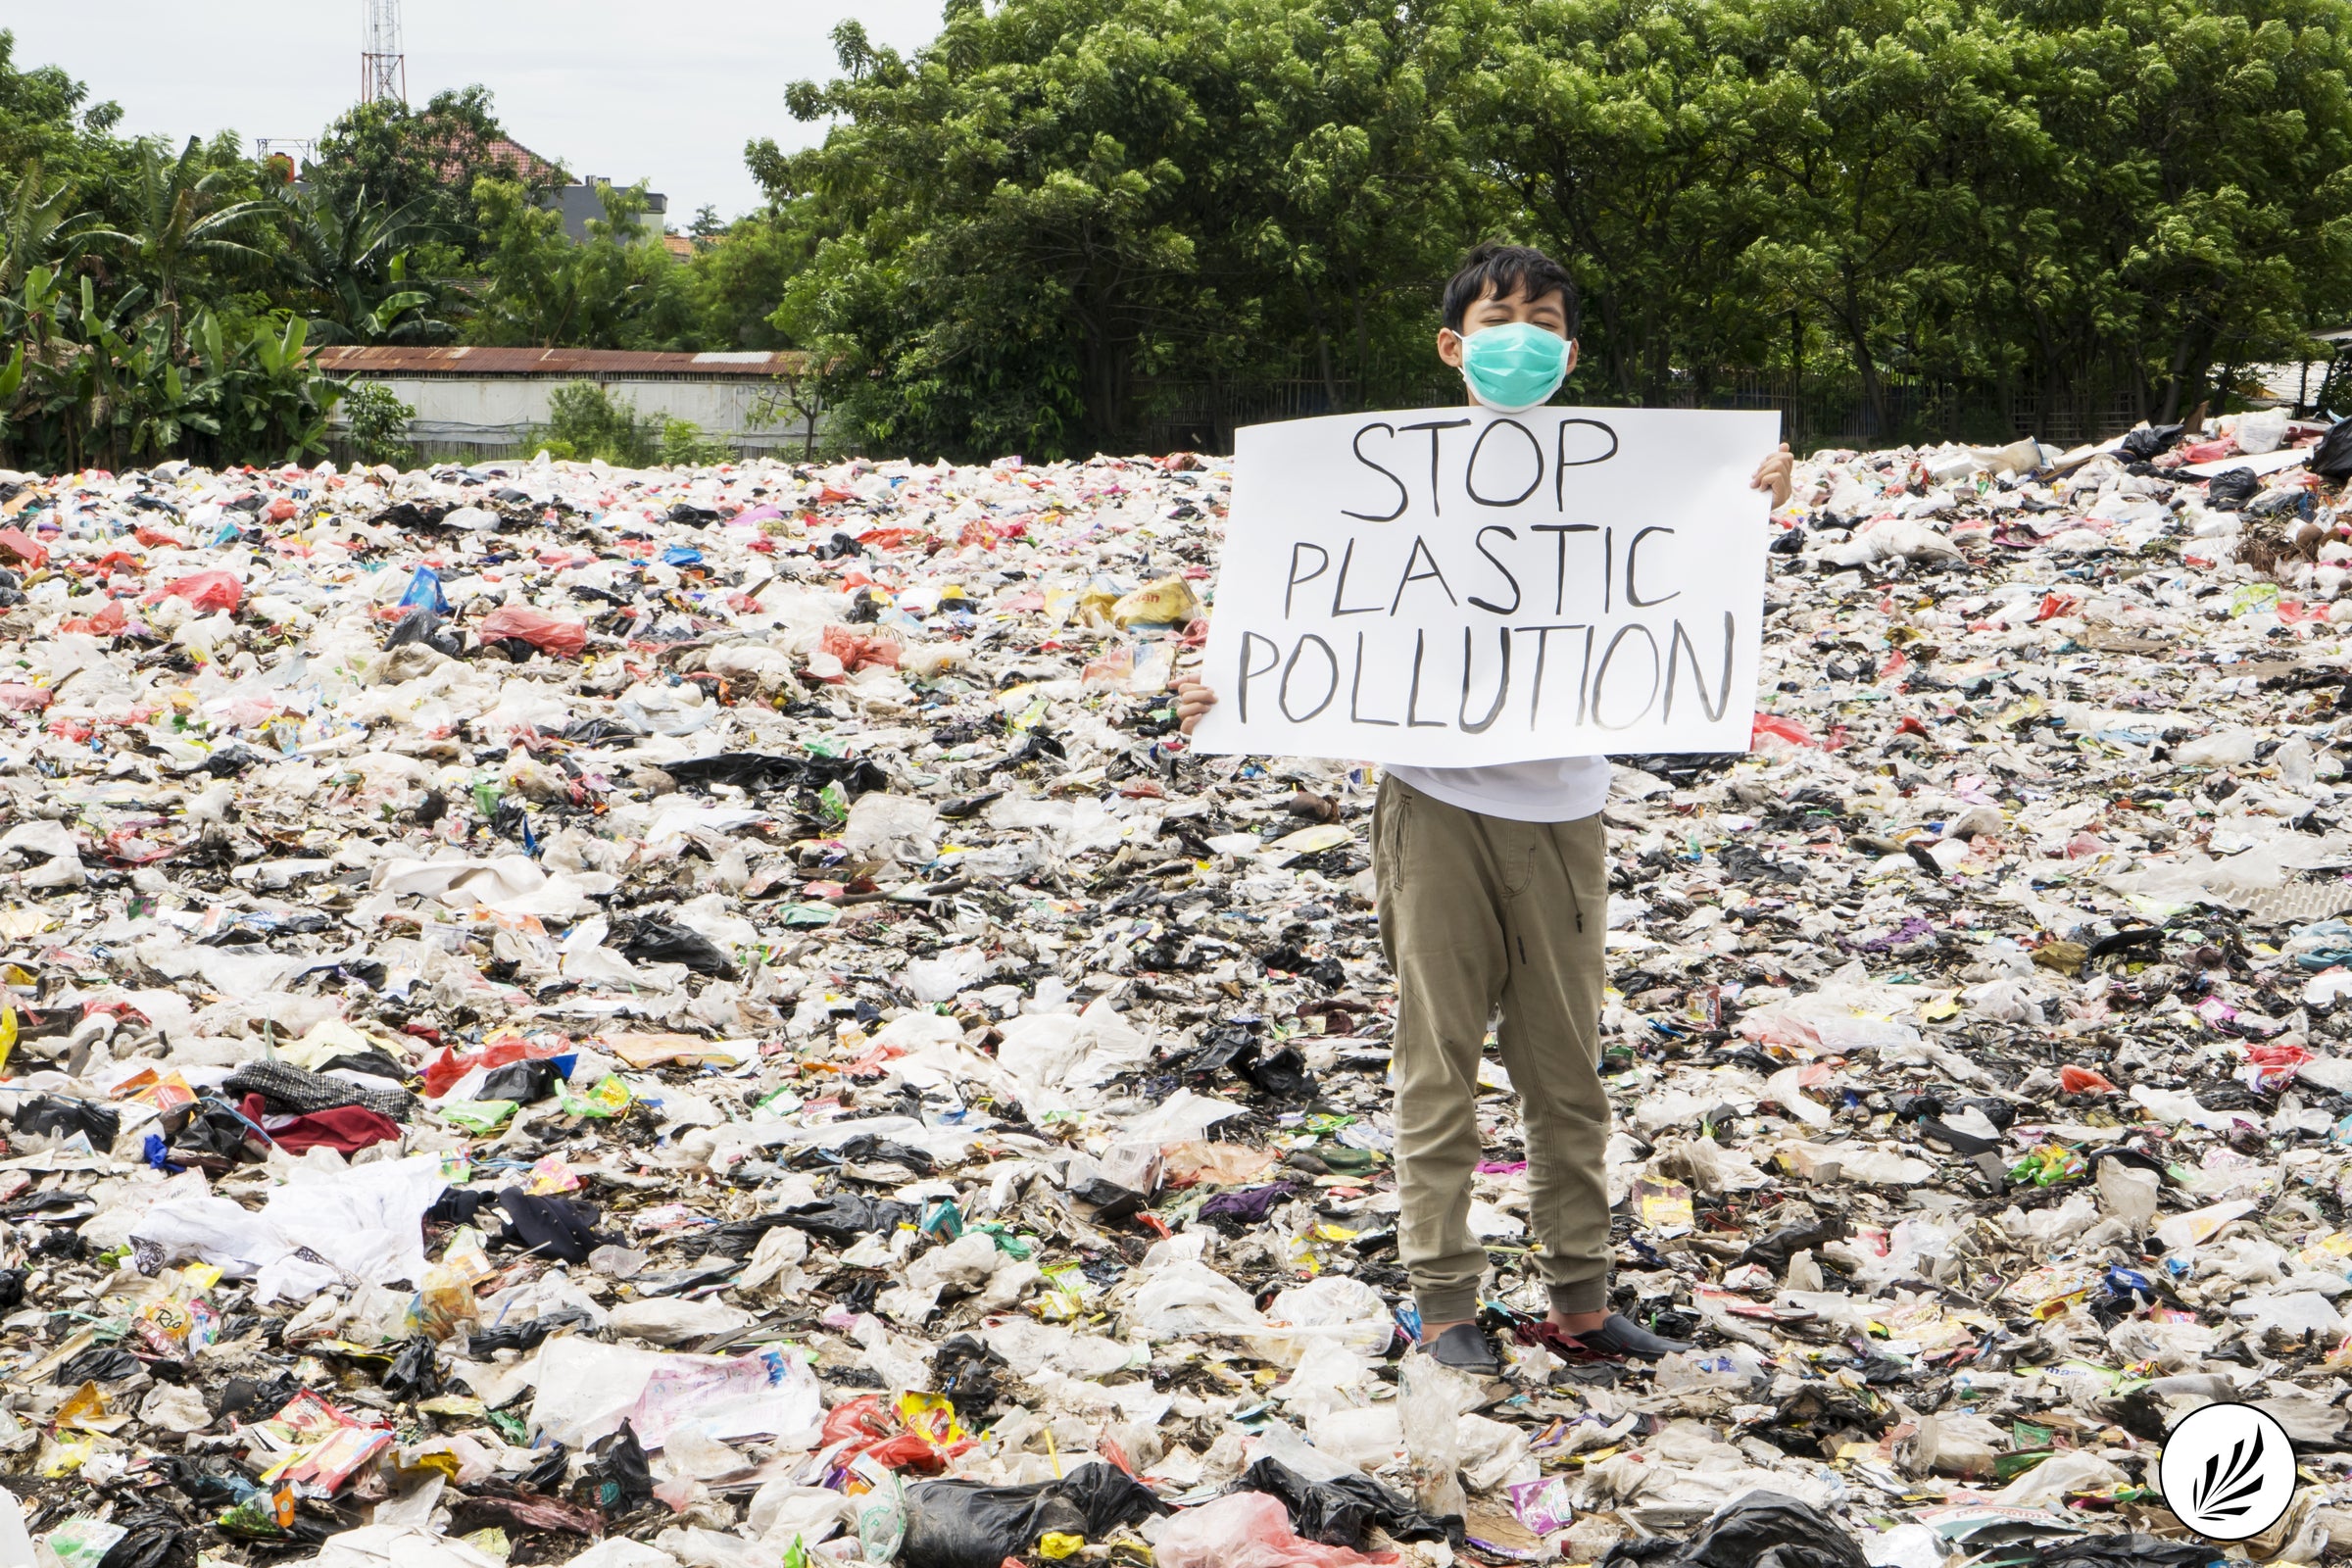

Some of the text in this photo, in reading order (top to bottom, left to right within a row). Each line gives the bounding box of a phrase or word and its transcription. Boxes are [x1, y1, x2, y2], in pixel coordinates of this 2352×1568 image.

[1340, 417, 1619, 523] STOP
[1285, 523, 1681, 619] PLASTIC
[1238, 611, 1735, 735] POLLUTION
